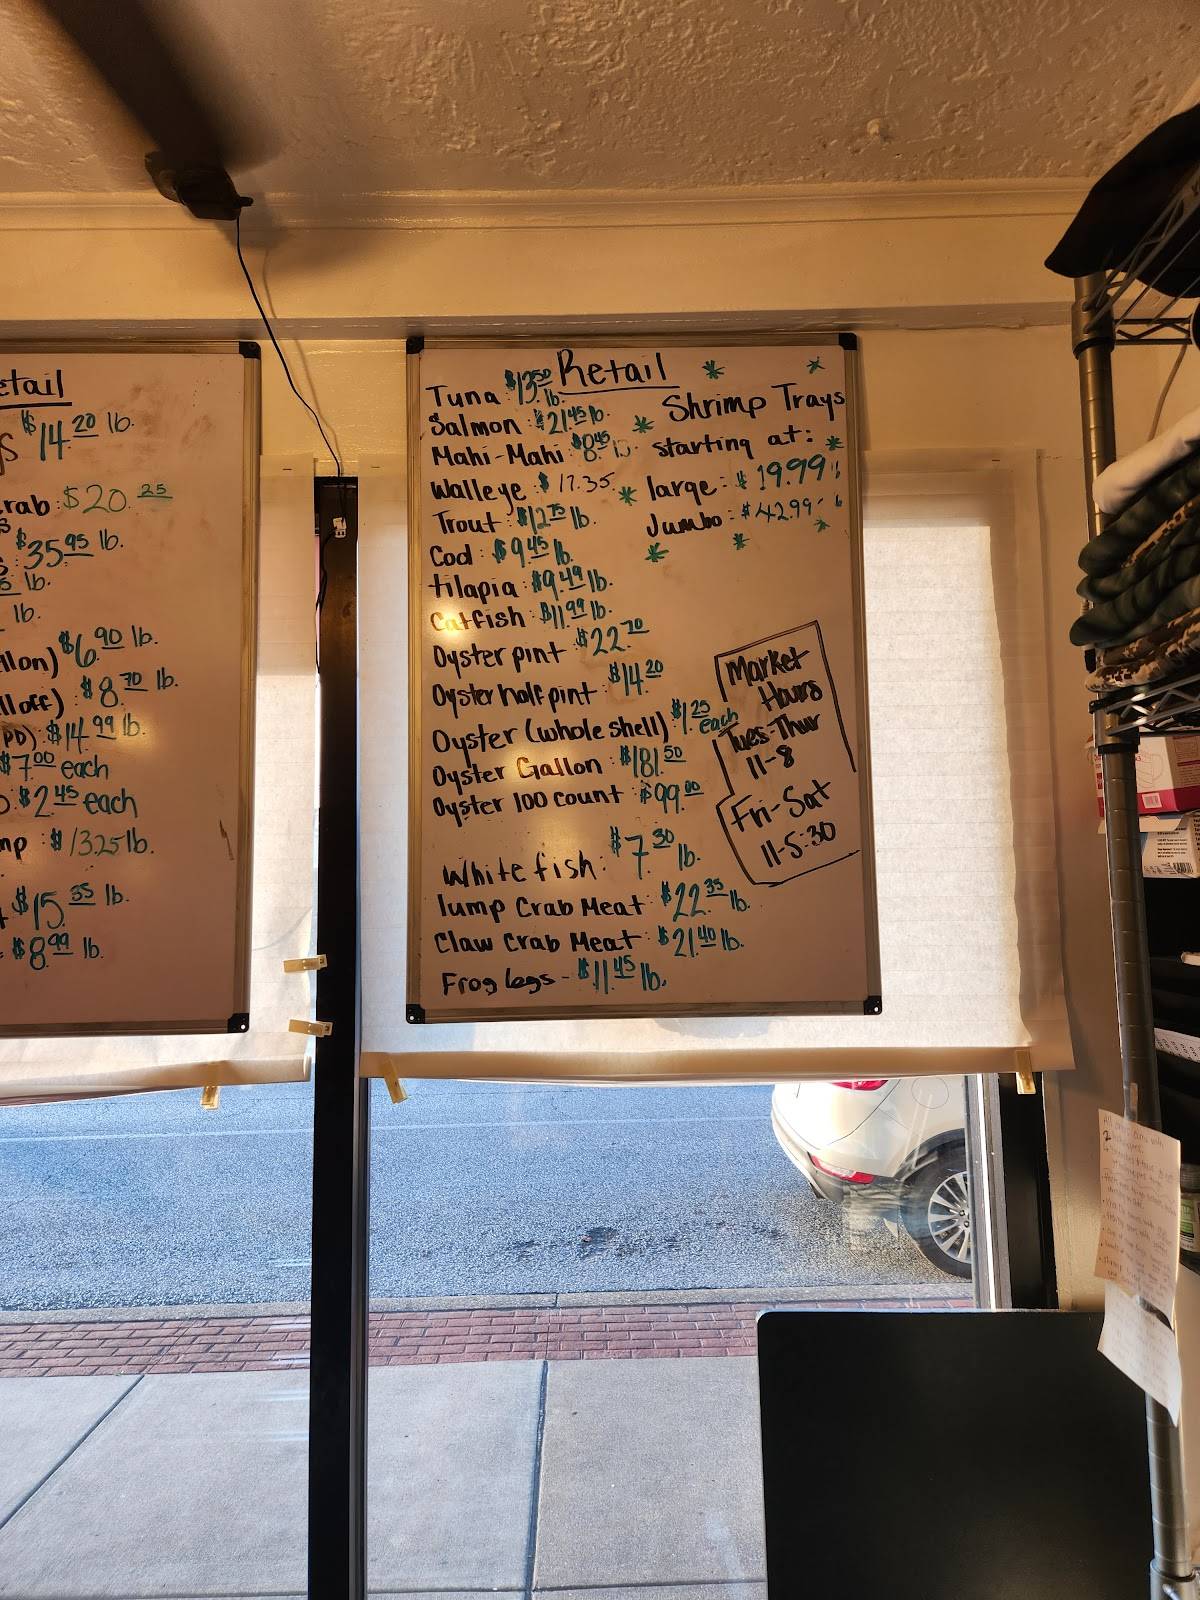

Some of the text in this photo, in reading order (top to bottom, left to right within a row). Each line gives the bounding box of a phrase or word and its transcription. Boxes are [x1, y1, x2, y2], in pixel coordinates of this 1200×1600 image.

[557, 349, 667, 387] Retail
[662, 383, 845, 421] Shrimp Trays
[107, 412, 135, 433] lb.
[652, 425, 813, 459] starting at:
[737, 454, 826, 490] $19.99
[0, 494, 61, 517] rab:
[570, 506, 597, 530] lb.
[99, 529, 124, 550] lb.
[553, 539, 574, 566] lb.
[25, 572, 51, 591] lb.
[587, 568, 613, 593] lb.
[14, 603, 41, 623] lb.
[590, 600, 612, 621] lb.
[0, 647, 58, 679] llon)
[132, 625, 158, 647] lb.
[433, 643, 506, 679] Oyster
[726, 647, 810, 686] Market
[157, 667, 179, 691] lb.
[432, 683, 493, 719] Oyster
[497, 681, 544, 707] half
[758, 679, 823, 711] Hours
[123, 713, 146, 737] lb.
[432, 723, 518, 768] Oyster
[525, 718, 604, 743] (whole
[699, 708, 739, 735] each
[718, 714, 820, 752] Tues-Thur
[61, 754, 109, 780] each
[746, 745, 795, 779] 11-8
[433, 764, 505, 795] Oyster
[83, 788, 138, 818] each
[433, 794, 504, 827] Oyster
[513, 790, 548, 813] 100
[731, 779, 831, 832] Fri-Sat
[126, 827, 155, 854] lb.
[761, 822, 836, 868] 11-5:30
[678, 843, 701, 871] lb.
[106, 884, 129, 906] lb.
[437, 894, 505, 923] lump
[516, 896, 574, 918] Crab
[729, 889, 750, 912] lb.
[83, 937, 104, 959] lb.
[434, 930, 494, 954] Claw
[503, 931, 560, 952] Crab
[720, 928, 744, 951] lb.
[441, 971, 498, 996] Frog
[641, 962, 666, 991] lb.
